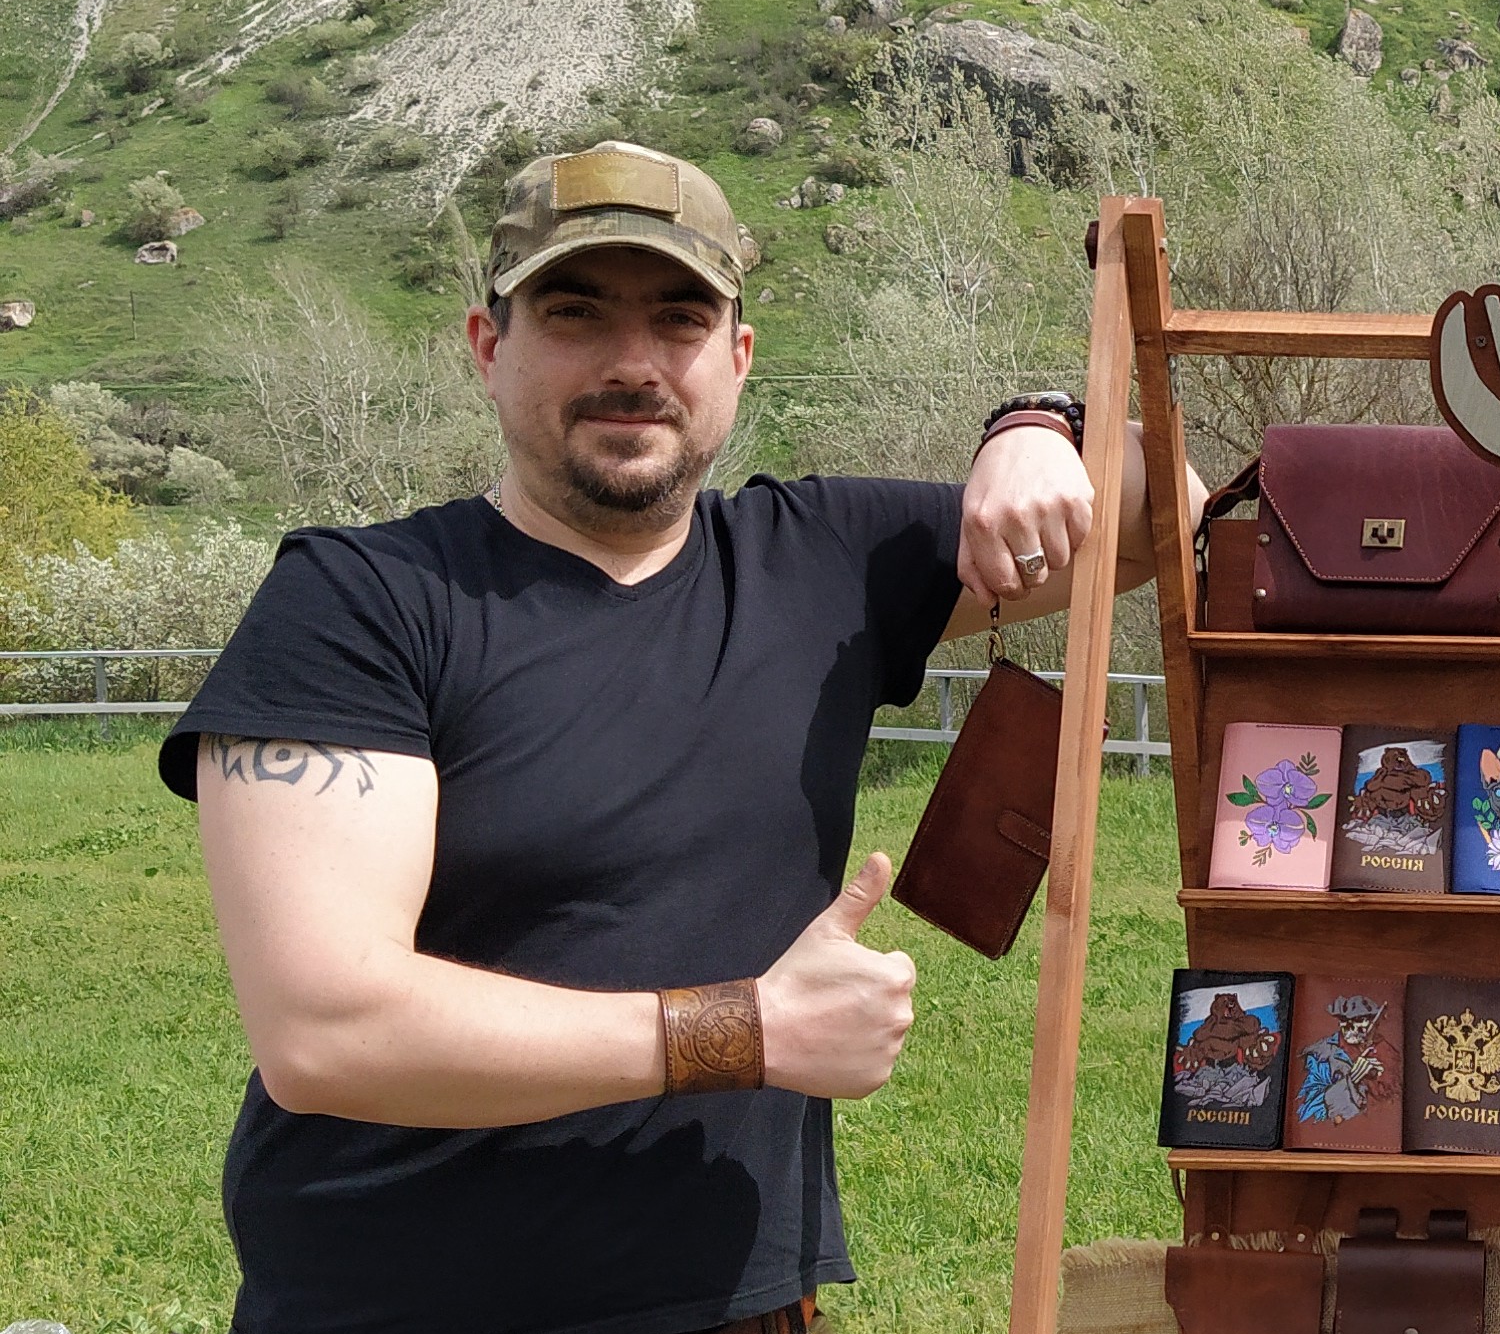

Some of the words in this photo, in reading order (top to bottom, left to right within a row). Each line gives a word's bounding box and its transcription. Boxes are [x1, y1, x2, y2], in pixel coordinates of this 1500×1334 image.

[1361, 854, 1424, 871] РОССИЯ
[1186, 1108, 1250, 1125] РОССИЯ
[1424, 1104, 1499, 1125] РОССИЯ
